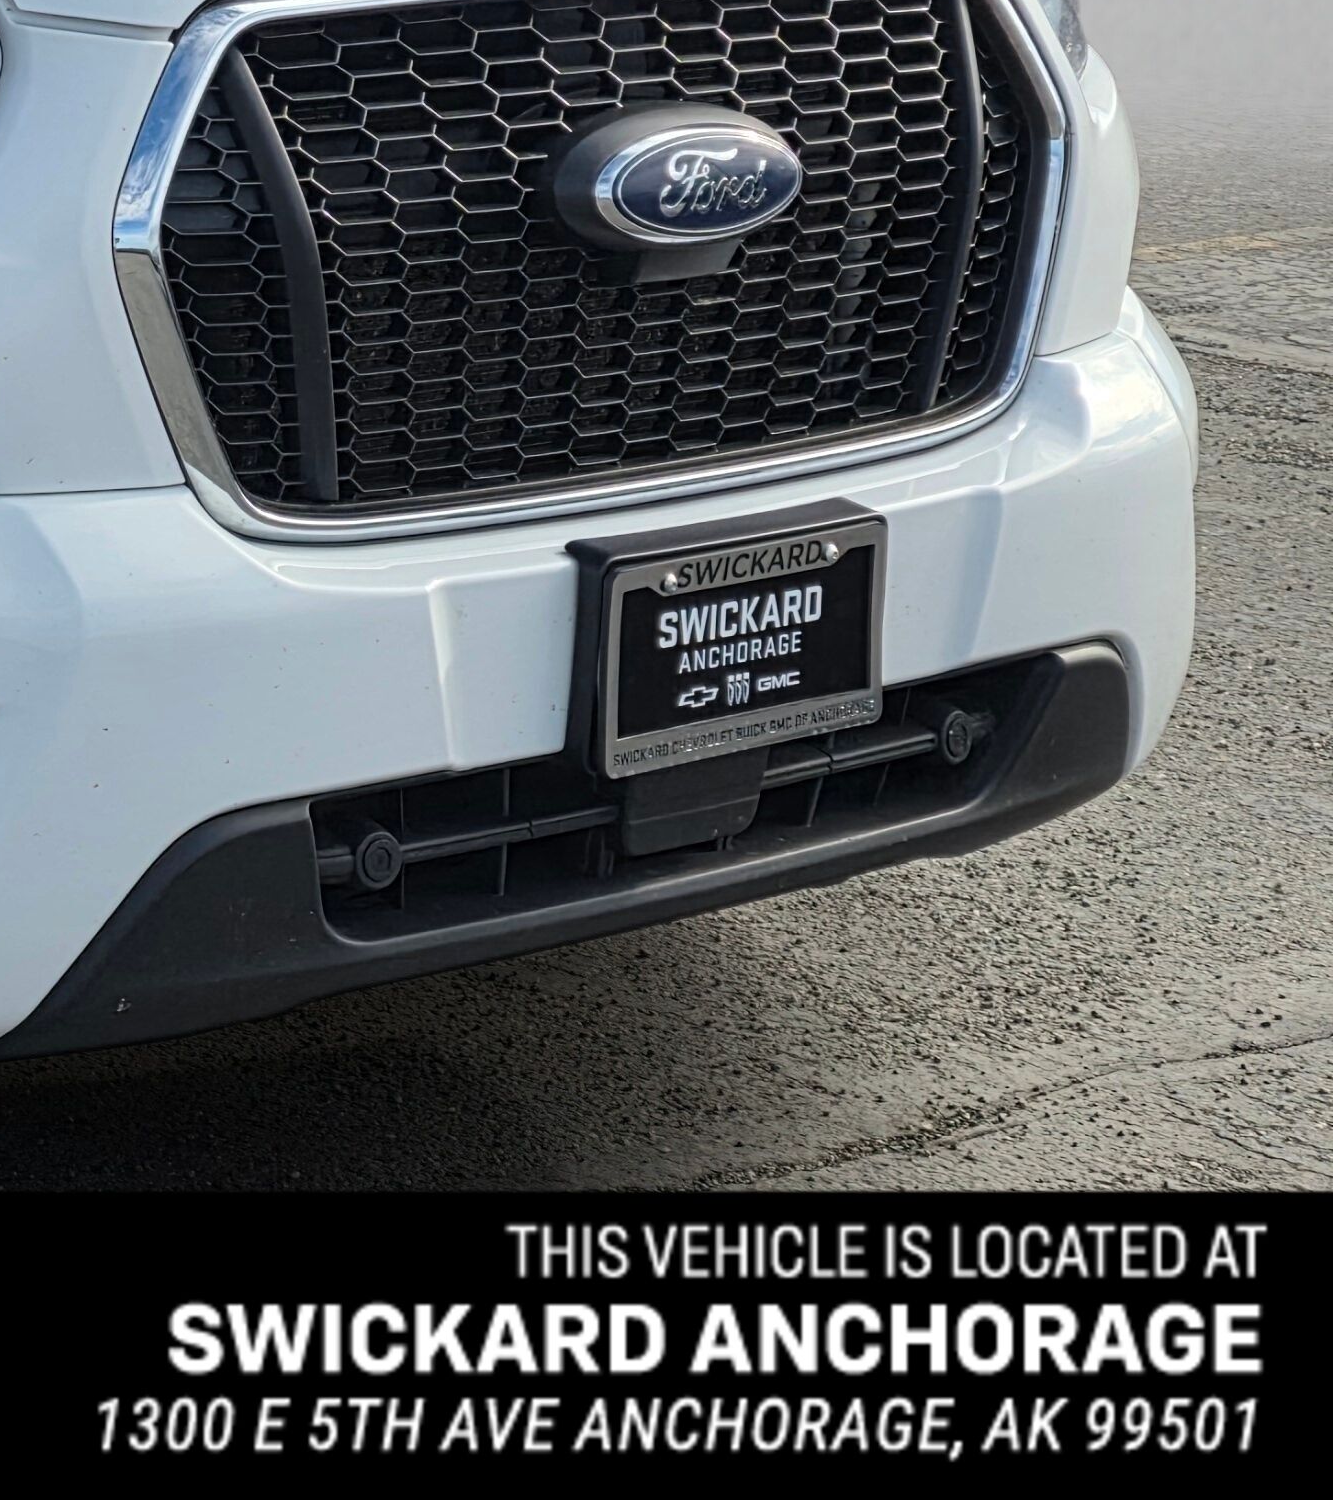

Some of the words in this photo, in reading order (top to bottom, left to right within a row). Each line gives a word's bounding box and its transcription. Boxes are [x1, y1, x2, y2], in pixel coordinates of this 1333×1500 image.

[660, 148, 767, 217] Ford
[678, 540, 822, 588] SWICKARD
[658, 585, 823, 649] SWICKARD
[678, 631, 802, 674] ANCHORAGE
[757, 671, 801, 692] GMC
[613, 743, 669, 766] SWICKARD
[672, 729, 734, 755] CHEVROLET
[735, 721, 767, 739] BUICK
[769, 716, 793, 733] GMC
[795, 712, 809, 727] OF
